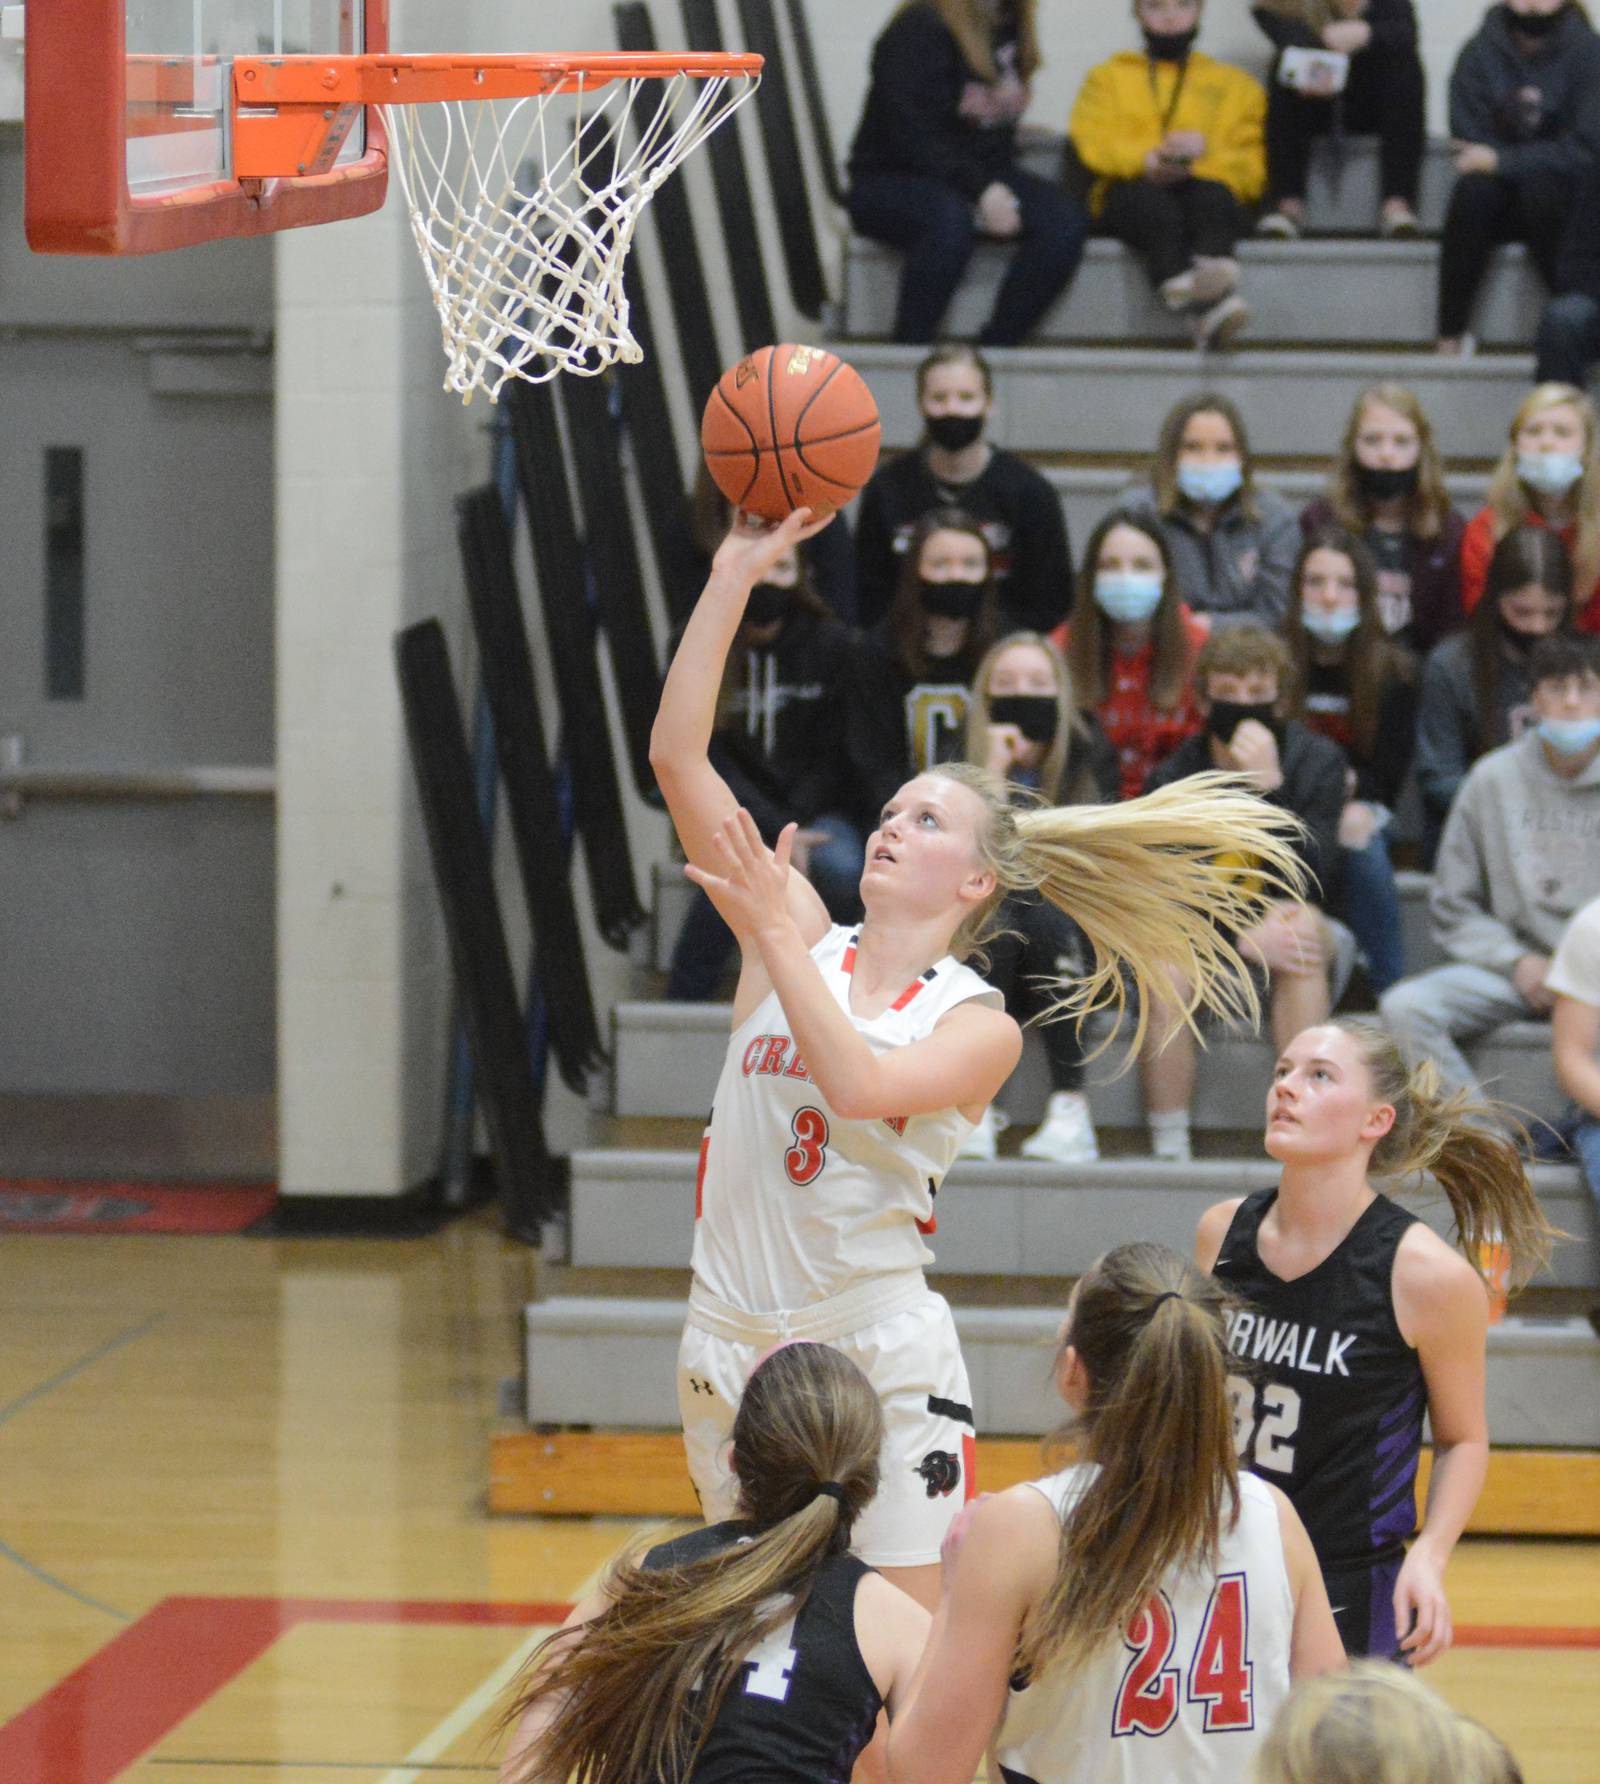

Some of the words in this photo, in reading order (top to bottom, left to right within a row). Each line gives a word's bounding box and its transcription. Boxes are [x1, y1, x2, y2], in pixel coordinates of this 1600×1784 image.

[784, 1105, 829, 1187] 3
[726, 1592, 800, 1704] 4
[1111, 1571, 1255, 1738] 24
